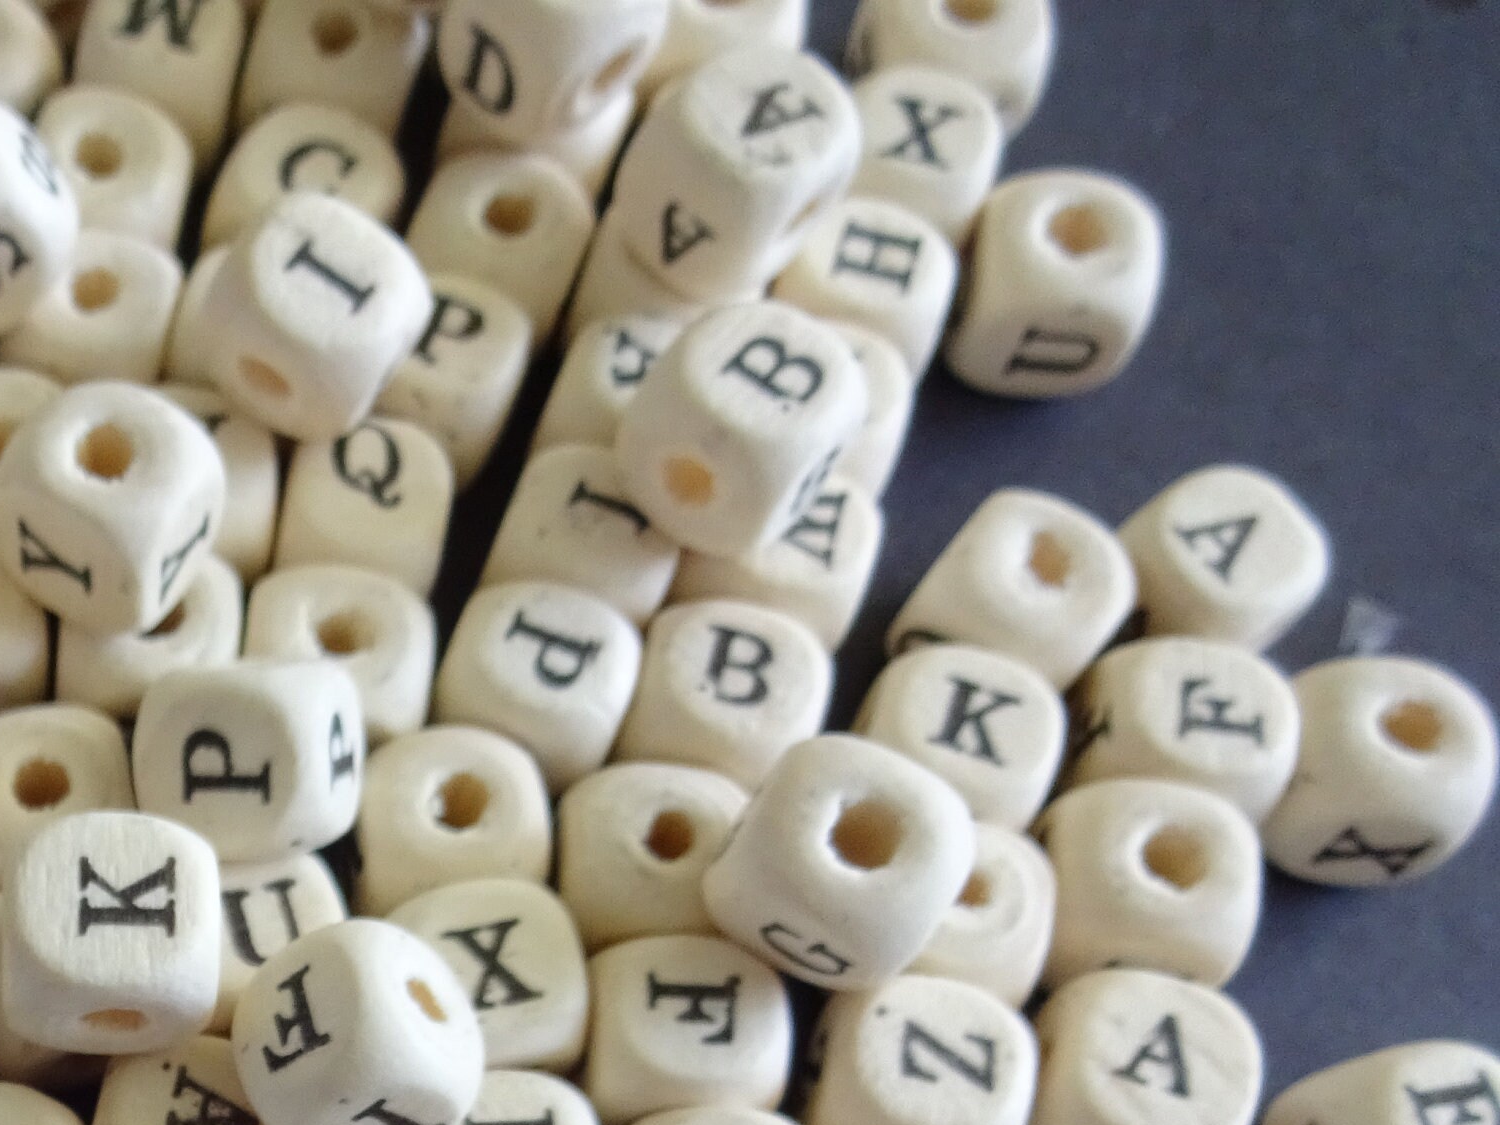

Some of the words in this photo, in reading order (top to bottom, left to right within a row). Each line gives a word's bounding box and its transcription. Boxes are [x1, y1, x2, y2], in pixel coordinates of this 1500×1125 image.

[457, 23, 516, 115] D
[880, 94, 959, 170] X
[284, 232, 377, 318] I
[830, 218, 924, 292] H
[412, 295, 483, 366] P
[721, 332, 825, 405] B
[1007, 325, 1101, 377] U
[331, 422, 405, 509] Q
[18, 516, 93, 596] Y
[1174, 514, 1261, 582] A
[505, 608, 602, 688] P
[705, 622, 774, 708] B
[927, 676, 1022, 770] K
[1177, 676, 1266, 746] F
[182, 727, 273, 807] P
[79, 855, 178, 938] K
[223, 877, 298, 967] U
[441, 917, 545, 1010] X
[760, 921, 852, 978] G
[262, 965, 332, 1074] F
[646, 973, 742, 1046] F
[902, 1018, 998, 1094] Z
[1112, 1012, 1190, 1100] A
